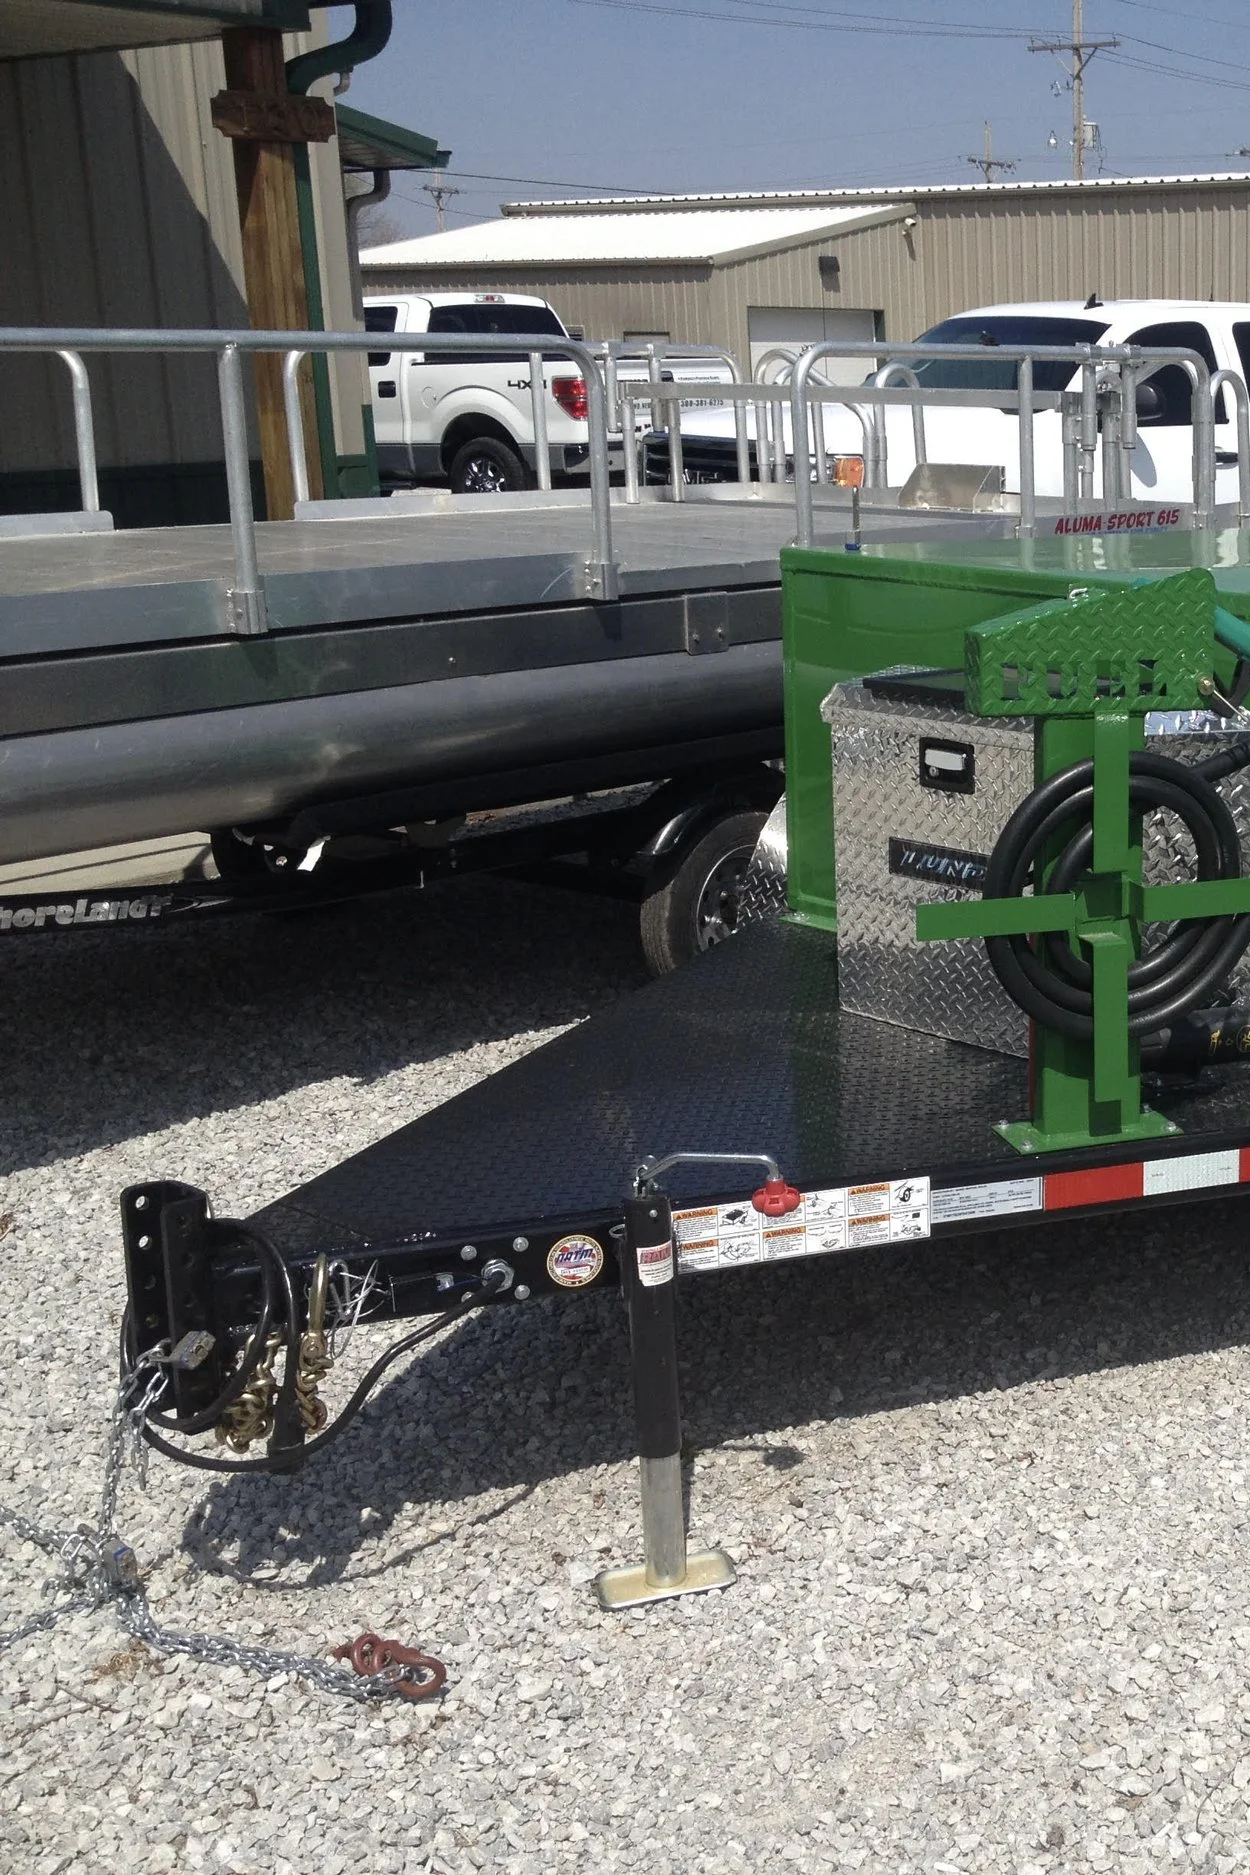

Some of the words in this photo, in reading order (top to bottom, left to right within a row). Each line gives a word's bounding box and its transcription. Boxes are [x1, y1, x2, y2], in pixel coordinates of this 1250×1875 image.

[1054, 515, 1102, 534] ALUMA
[1157, 508, 1180, 526] 615
[856, 1184, 885, 1194] WARNING
[682, 1208, 713, 1219] WARNING
[856, 1214, 885, 1225] WARNING
[771, 1227, 801, 1238] WARNING
